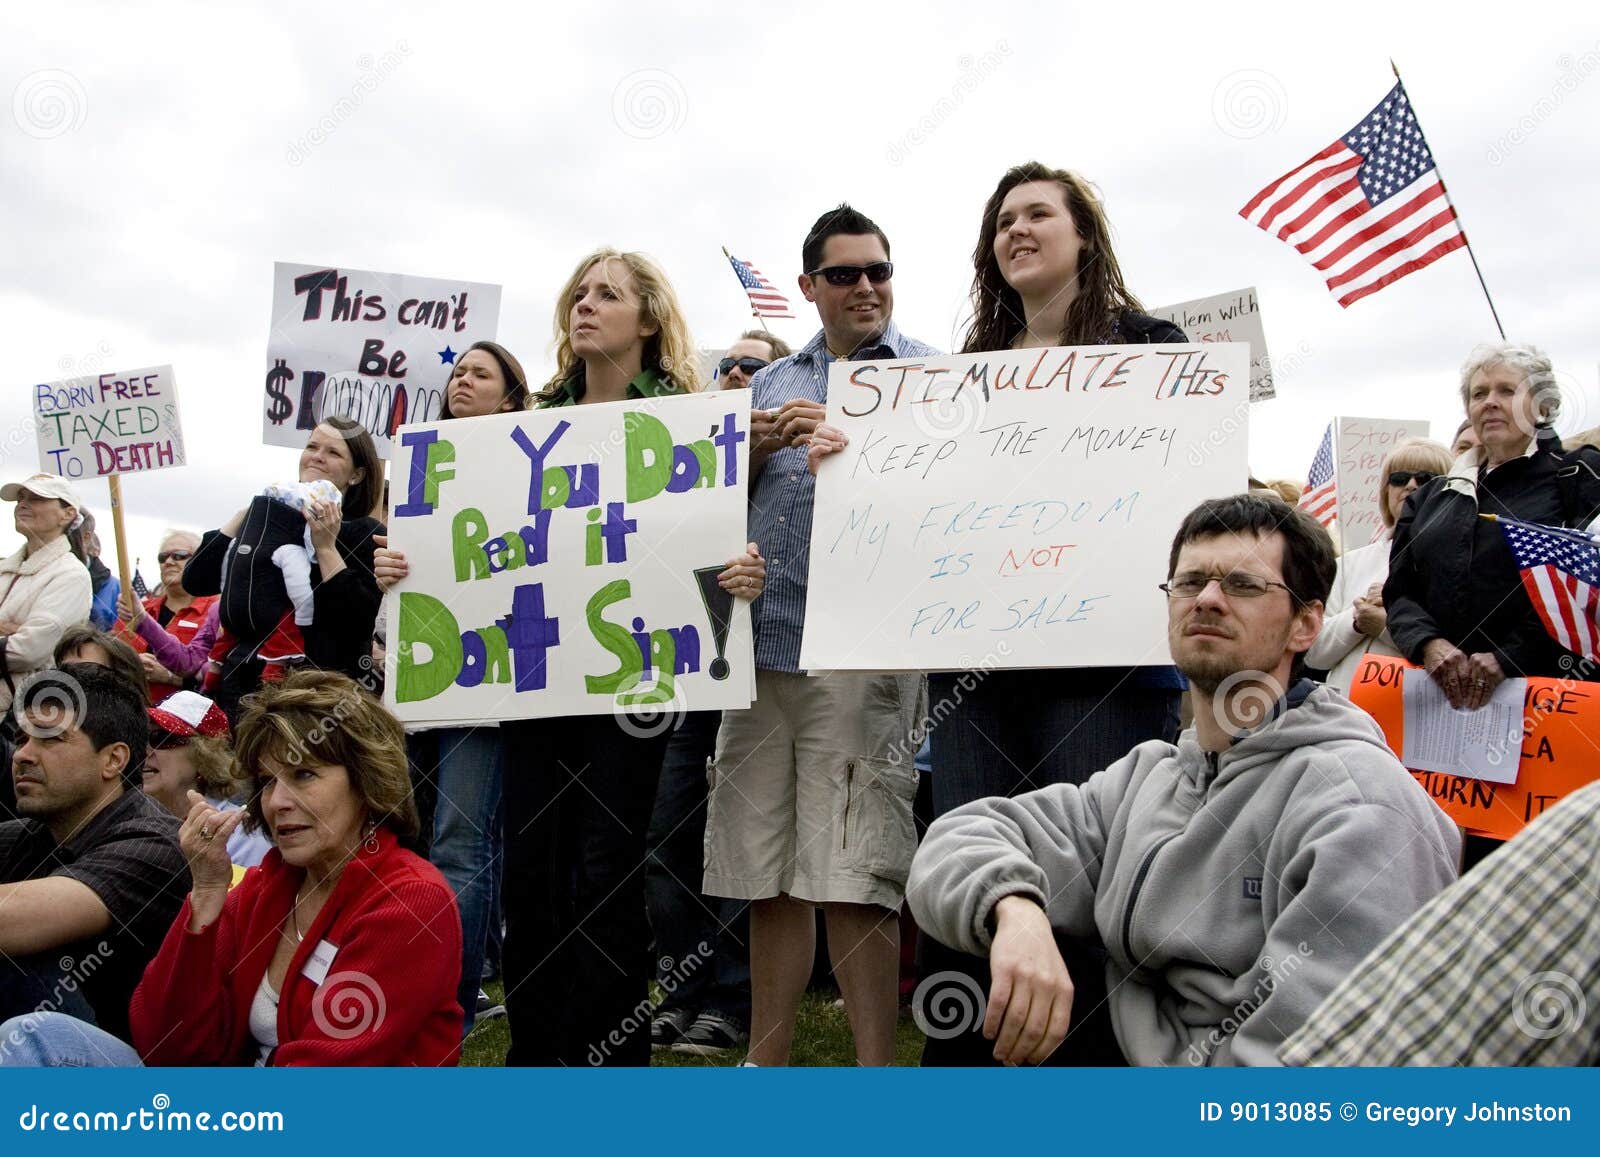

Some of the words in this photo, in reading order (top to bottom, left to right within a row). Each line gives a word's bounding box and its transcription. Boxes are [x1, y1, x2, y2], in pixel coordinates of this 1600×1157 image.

[294, 269, 386, 323] This
[397, 292, 469, 331] can't
[1219, 294, 1259, 320] with
[358, 339, 408, 378] Be
[36, 384, 95, 412] BORN
[99, 373, 161, 403] FREE
[842, 349, 1143, 418] STIMULATE
[1155, 350, 1230, 401] THIS
[43, 406, 160, 446] TAXED
[47, 448, 83, 477] TO
[90, 440, 174, 475] DEATH
[395, 429, 456, 517] IF
[510, 420, 600, 516] You
[623, 412, 746, 504] Don't
[851, 428, 958, 480] KEEP
[1061, 426, 1177, 467] MONEY
[913, 490, 1142, 547] FREEDOM
[451, 505, 552, 583] Read
[585, 502, 637, 566] it
[930, 551, 974, 579] IS
[997, 544, 1077, 577] NOT
[909, 600, 978, 640] FOR
[990, 594, 1113, 632] SALE
